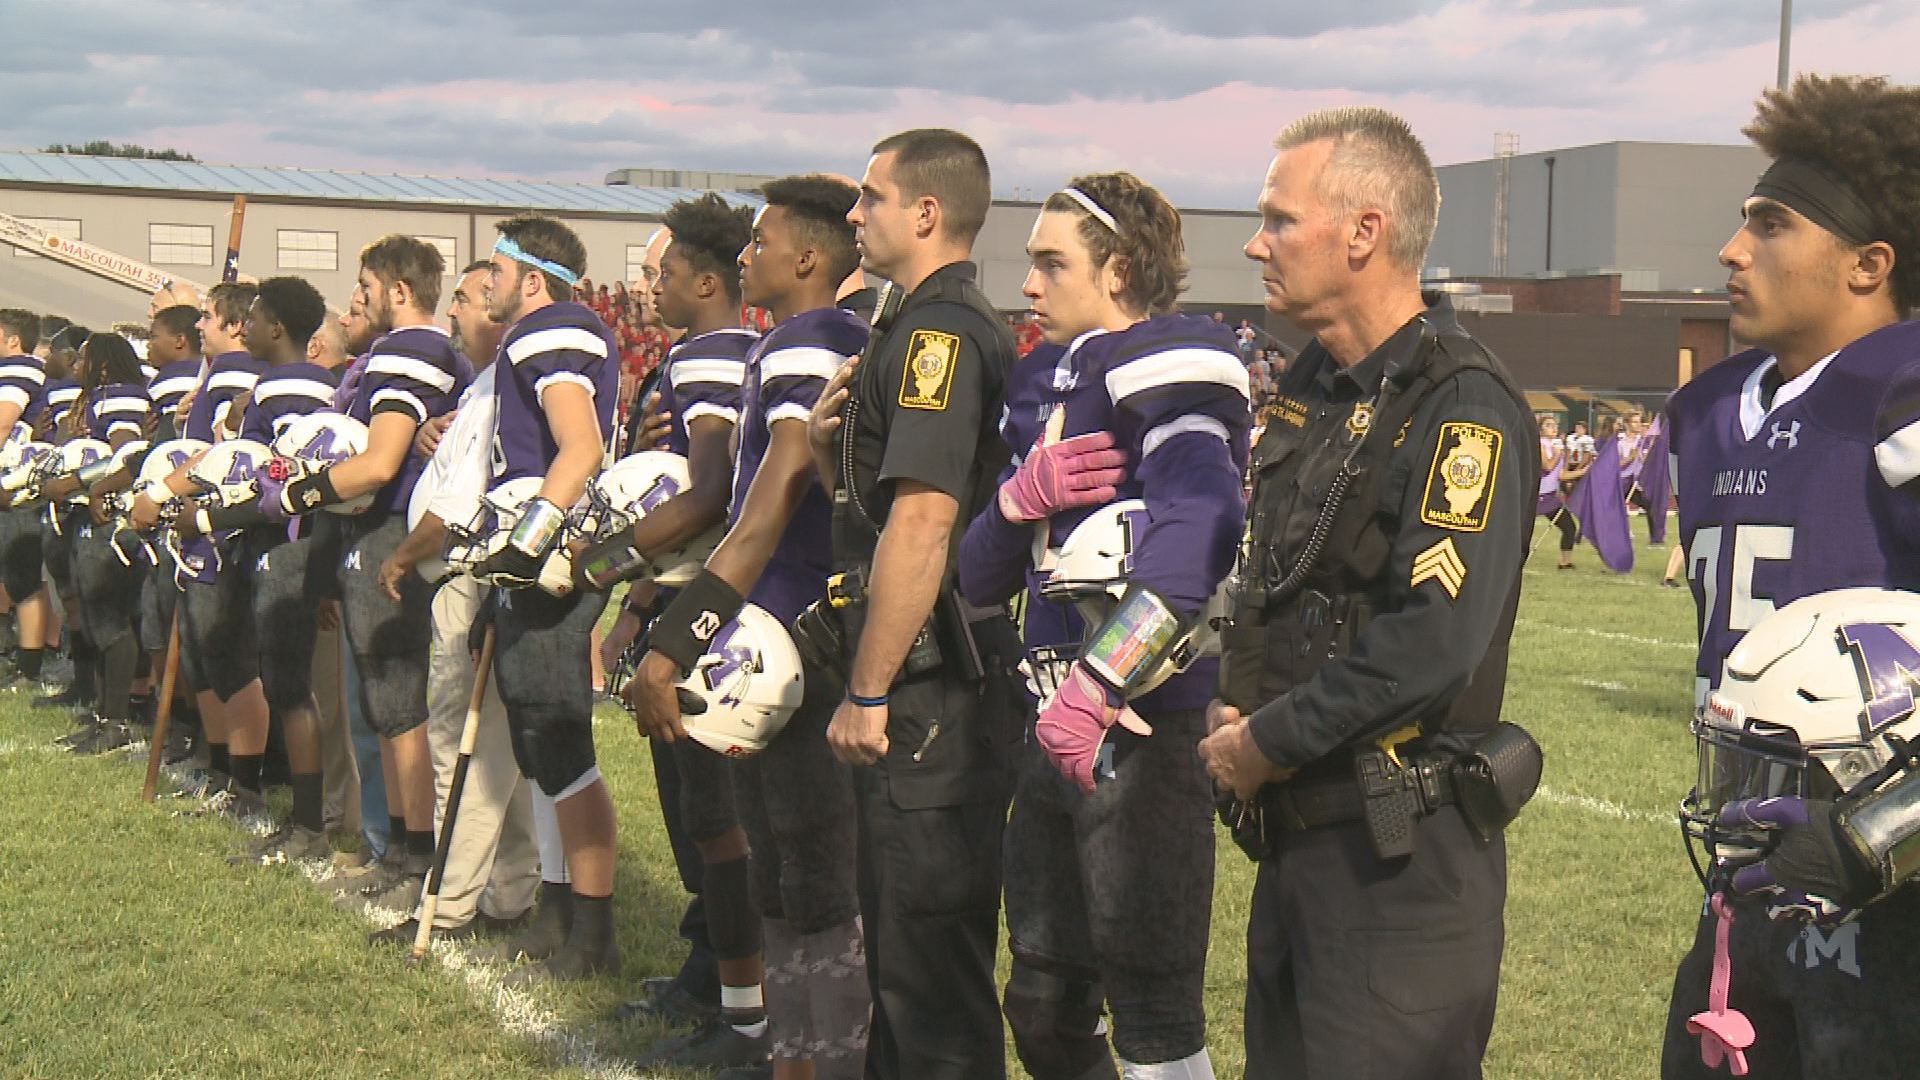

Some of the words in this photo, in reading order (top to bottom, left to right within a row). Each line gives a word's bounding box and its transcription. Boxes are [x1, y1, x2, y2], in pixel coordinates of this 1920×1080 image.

[61, 240, 143, 278] MASCOUTAH
[1450, 426, 1494, 446] POLICE
[1712, 469, 1768, 496] INDIANS
[1427, 508, 1479, 527] MASCOUTAH
[344, 549, 362, 571] M
[1804, 922, 1861, 978] M
